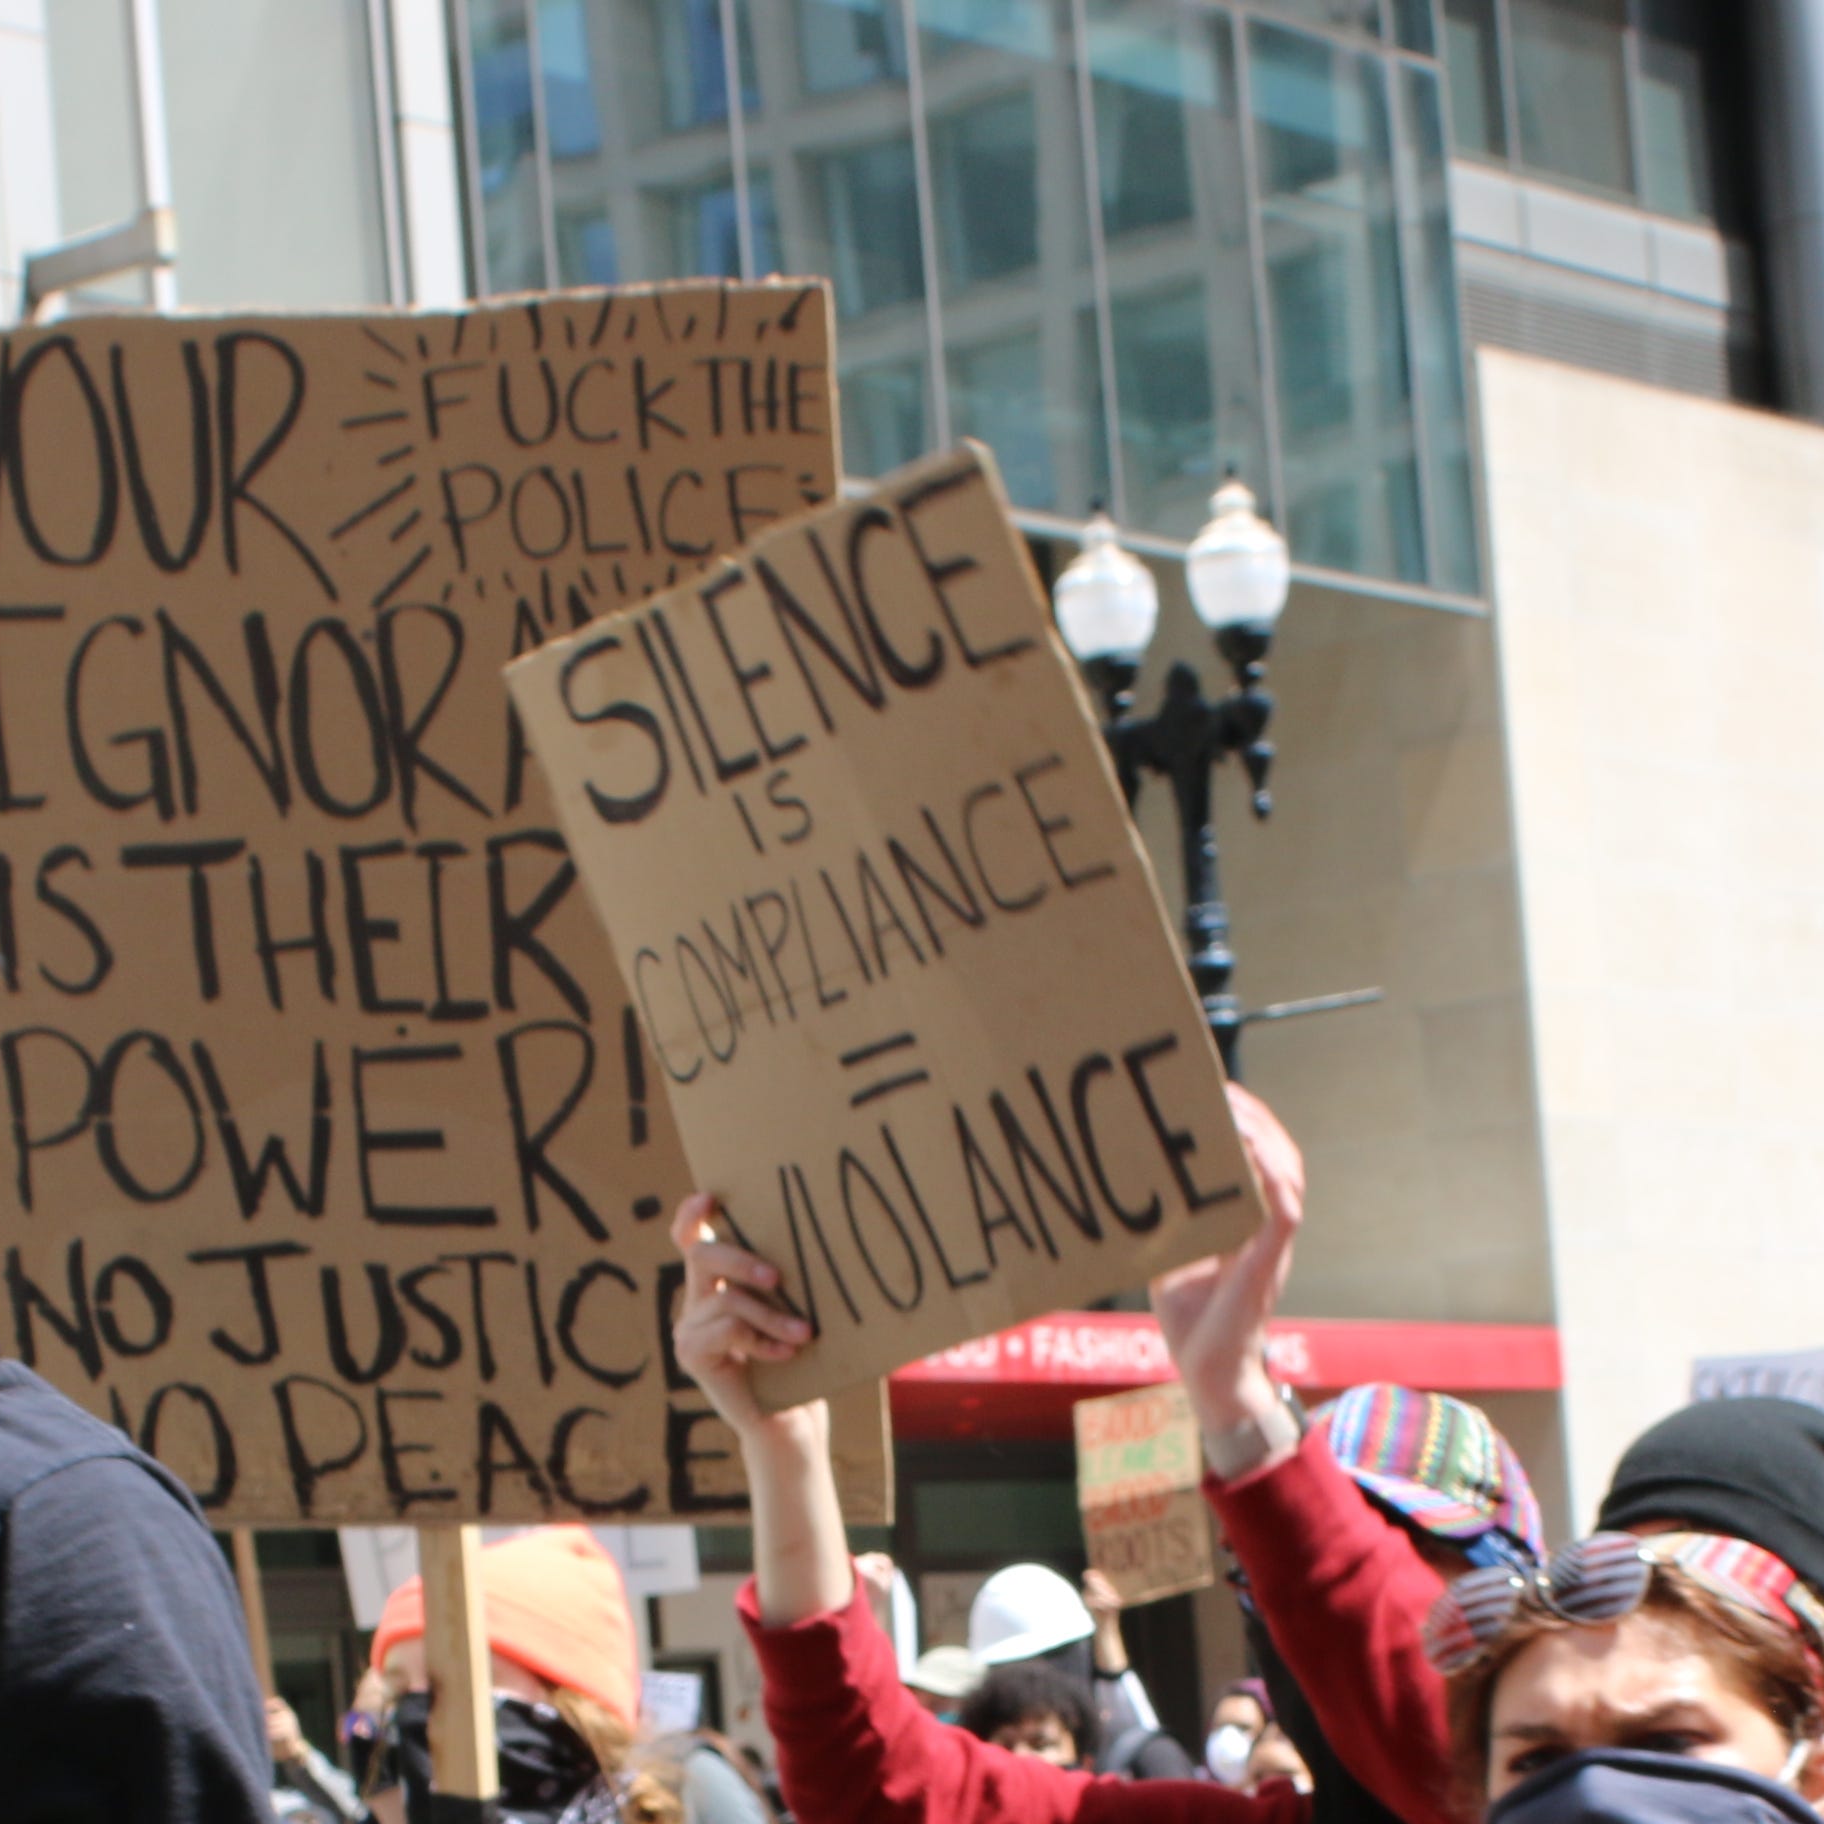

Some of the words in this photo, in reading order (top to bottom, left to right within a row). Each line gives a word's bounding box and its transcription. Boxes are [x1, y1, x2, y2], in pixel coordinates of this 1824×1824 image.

[423, 355, 686, 452] FUCK
[692, 357, 826, 436] THE
[439, 462, 786, 573] POLICE
[558, 469, 1041, 825] SILENCE
[731, 767, 815, 855] IS
[120, 828, 592, 1024] THEIR
[630, 752, 1116, 1086] COMPLIANCE
[0, 1004, 663, 1242] POWER!
[715, 1032, 1243, 1340] VIOLANCE
[4, 1238, 175, 1382] NO
[273, 1375, 752, 1518] PEACE
